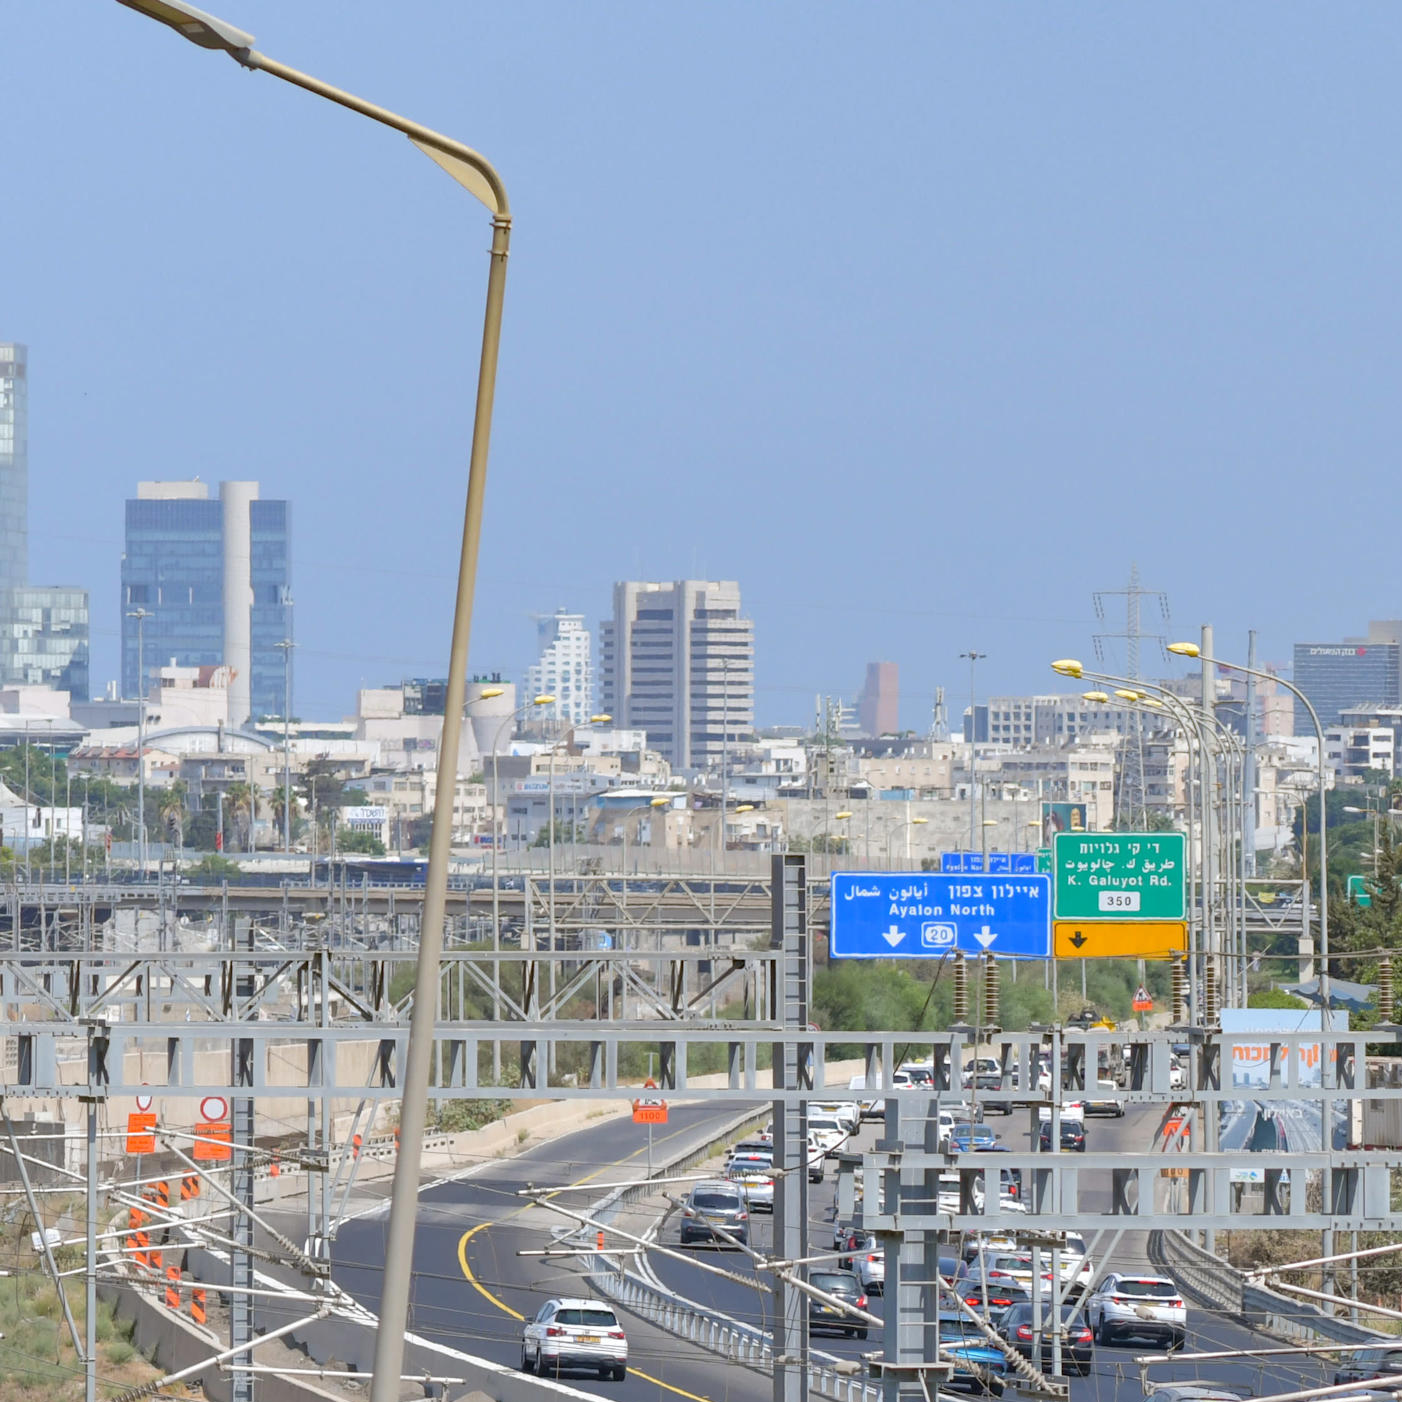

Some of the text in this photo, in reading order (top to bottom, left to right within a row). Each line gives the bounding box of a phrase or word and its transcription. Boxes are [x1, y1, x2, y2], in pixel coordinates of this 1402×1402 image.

[1080, 842, 1120, 854] גלויות
[1068, 875, 1172, 888] K. Galuyot Rd.
[844, 882, 928, 902] أيالون شمال
[949, 884, 1040, 899] איילון צפון
[1107, 896, 1131, 906] 350
[889, 904, 995, 918] Ayalon North
[931, 929, 948, 941] 20
